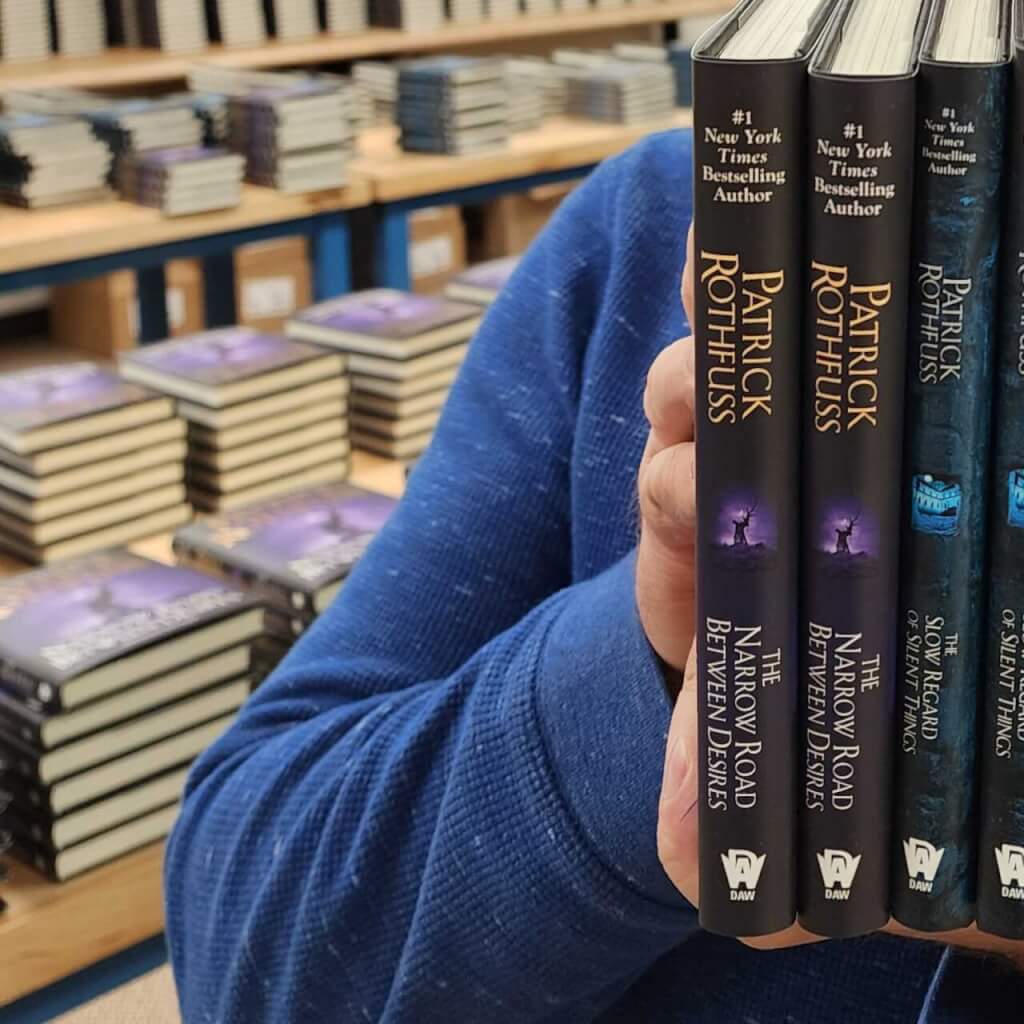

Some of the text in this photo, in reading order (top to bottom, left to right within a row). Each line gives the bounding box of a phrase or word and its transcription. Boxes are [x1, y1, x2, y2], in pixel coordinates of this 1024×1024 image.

[732, 109, 752, 125] #1
[924, 119, 975, 134] New York
[704, 127, 782, 145] New York
[843, 122, 864, 139] #1
[931, 134, 964, 147] Times
[718, 147, 768, 164] Times
[816, 139, 892, 159] New York
[922, 147, 976, 164] Bestselling
[702, 165, 786, 186] Bestselling
[828, 159, 878, 178] Times
[928, 163, 968, 176] Author
[713, 186, 773, 203] Author
[814, 176, 896, 200] Bestselling
[824, 198, 882, 217] Author
[918, 262, 943, 385] ROTHFUSS
[939, 277, 972, 383] PATRICK
[700, 249, 740, 424] ROTHFUSS
[741, 269, 784, 420] PATRICK
[811, 259, 848, 435] ROTHFUSS
[846, 281, 892, 432] PATRICK
[944, 632, 959, 657] THE
[761, 647, 781, 687] THE
[860, 653, 880, 693] THE
[920, 615, 945, 741] SLOW REGARD
[902, 609, 923, 755] OF SILENT THINGS
[995, 608, 1020, 759] OF SILENT THINGS
[706, 617, 733, 812] BETWEEN DESIRES
[734, 625, 762, 809] NARROW ROAD
[805, 621, 833, 812] BETWEEN DESIRES
[831, 632, 863, 811] NARROW ROAD
[730, 890, 755, 901] DAW
[824, 889, 850, 900] DAW
[908, 878, 933, 893] DAW
